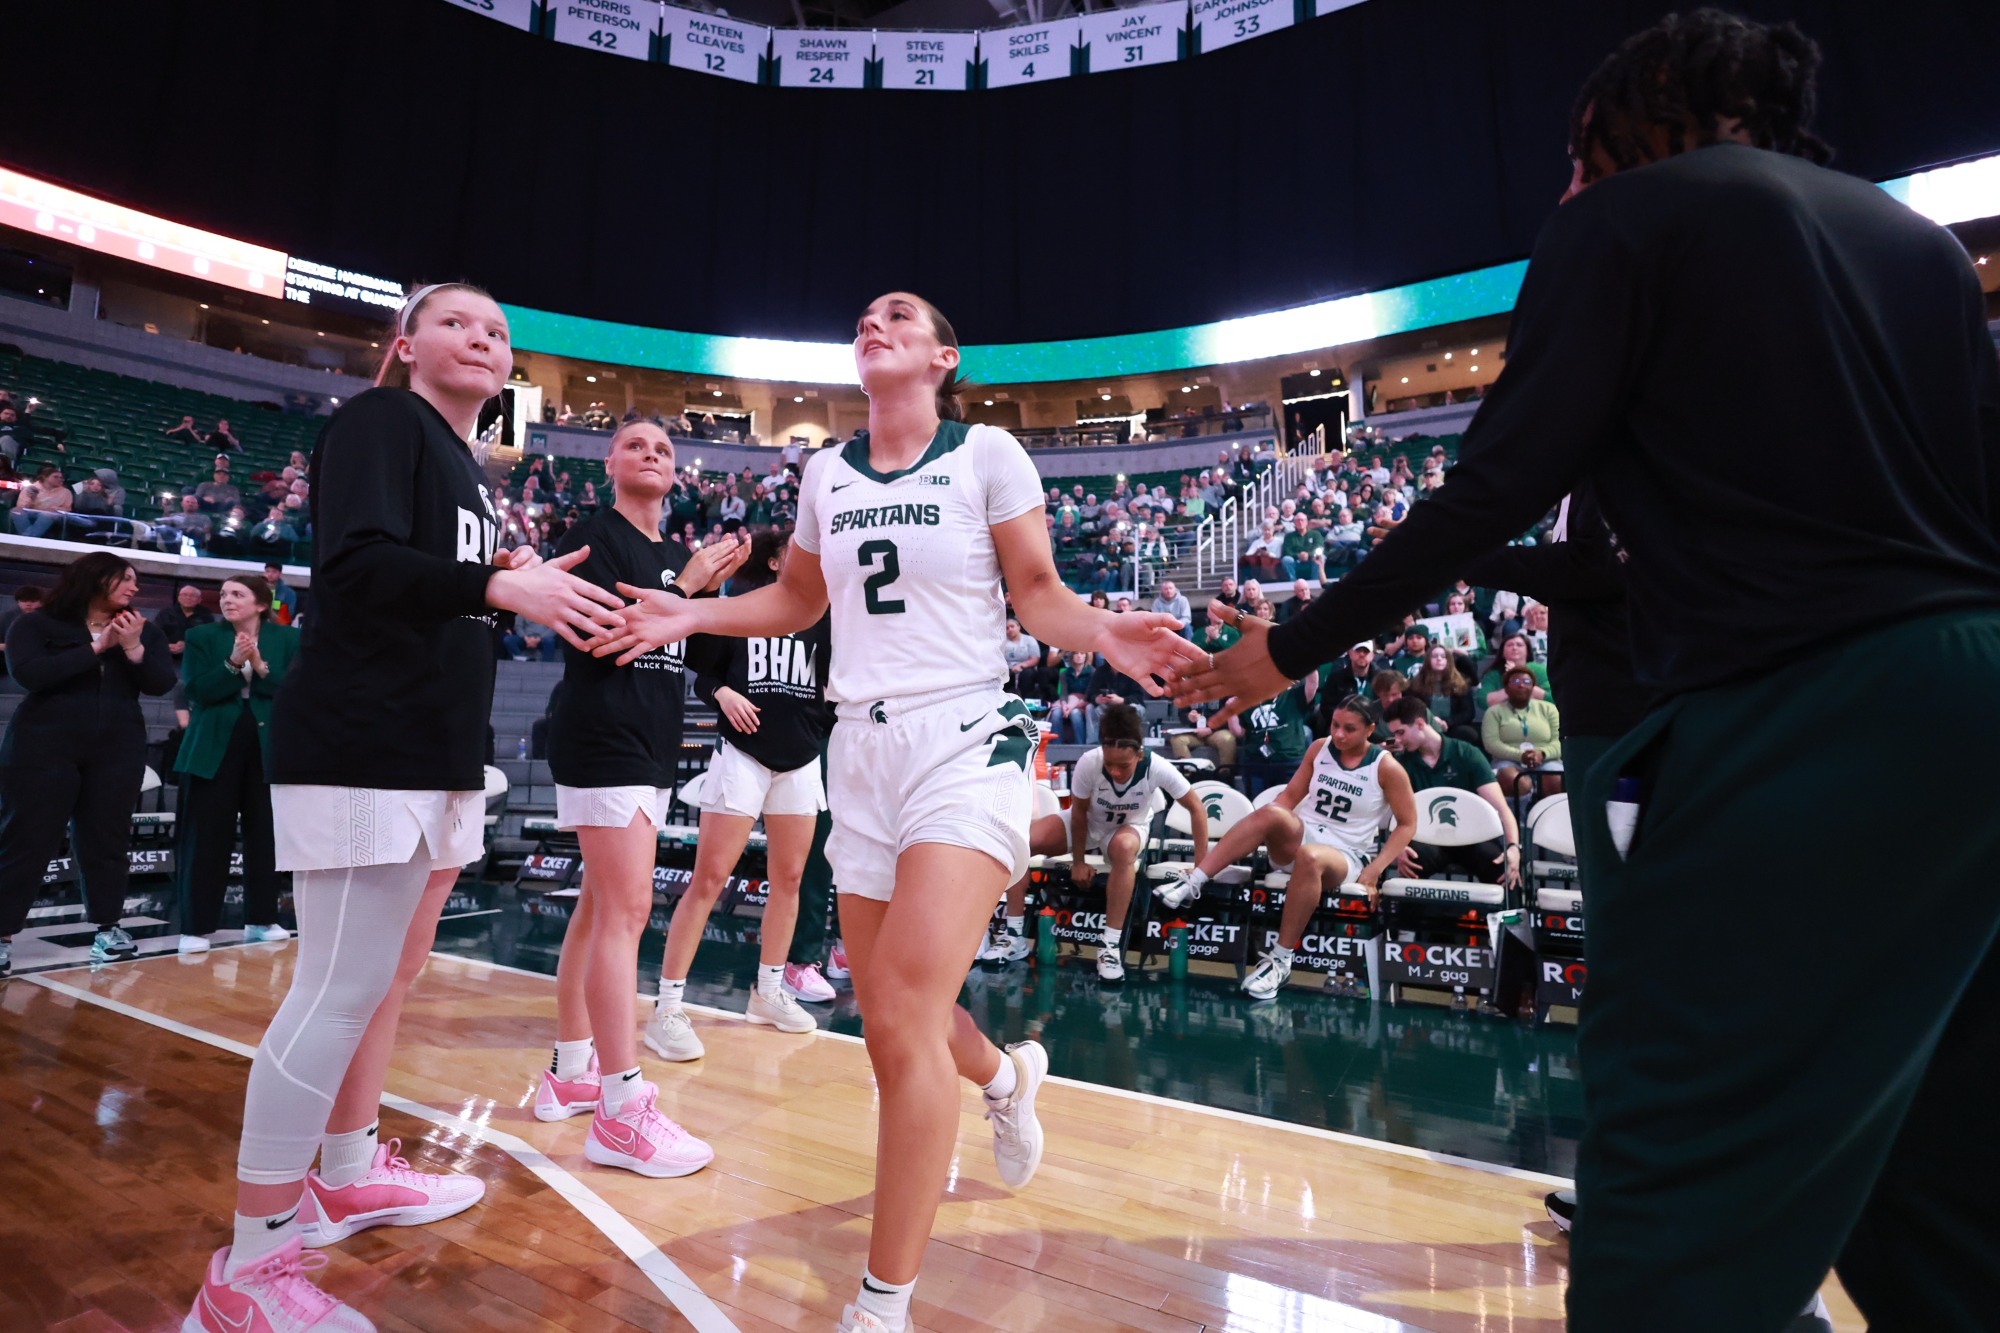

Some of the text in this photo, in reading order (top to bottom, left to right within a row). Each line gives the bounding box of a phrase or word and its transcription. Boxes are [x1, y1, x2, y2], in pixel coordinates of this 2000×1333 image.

[568, 6, 640, 31] PETERSON
[1121, 16, 1146, 28] JAY
[1234, 15, 1260, 37] 33
[690, 20, 743, 40] MATEEN
[1009, 31, 1050, 46] SCOTT
[1106, 26, 1162, 43] VINCENT
[588, 30, 618, 49] 42
[686, 33, 745, 54] CLEAVES
[799, 39, 847, 49] SHAWN
[906, 41, 944, 51] STEVE
[796, 52, 850, 62] RESPERT
[907, 53, 943, 63] SMITH
[1009, 43, 1050, 59] SKILES
[1124, 45, 1143, 62] 31
[704, 53, 725, 72] 12
[1022, 62, 1035, 78] 4
[809, 68, 835, 83] 24
[915, 69, 935, 85] 21
[285, 286, 310, 304] THE
[919, 475, 950, 485] BIG
[831, 504, 940, 535] SPARTANS
[858, 539, 906, 614] 2
[634, 662, 660, 670] BLACK
[748, 637, 816, 687] BHM
[1317, 774, 1363, 797] SPARTANS
[1097, 797, 1139, 811] SPARTANS
[1315, 788, 1352, 823] 22
[524, 855, 572, 870] ROCKET
[653, 867, 681, 882] CKET
[1405, 886, 1469, 901] SPARTANS
[1055, 909, 1107, 929] OCKE
[1265, 930, 1366, 957] RCKET
[1385, 942, 1495, 970] ROCKET
